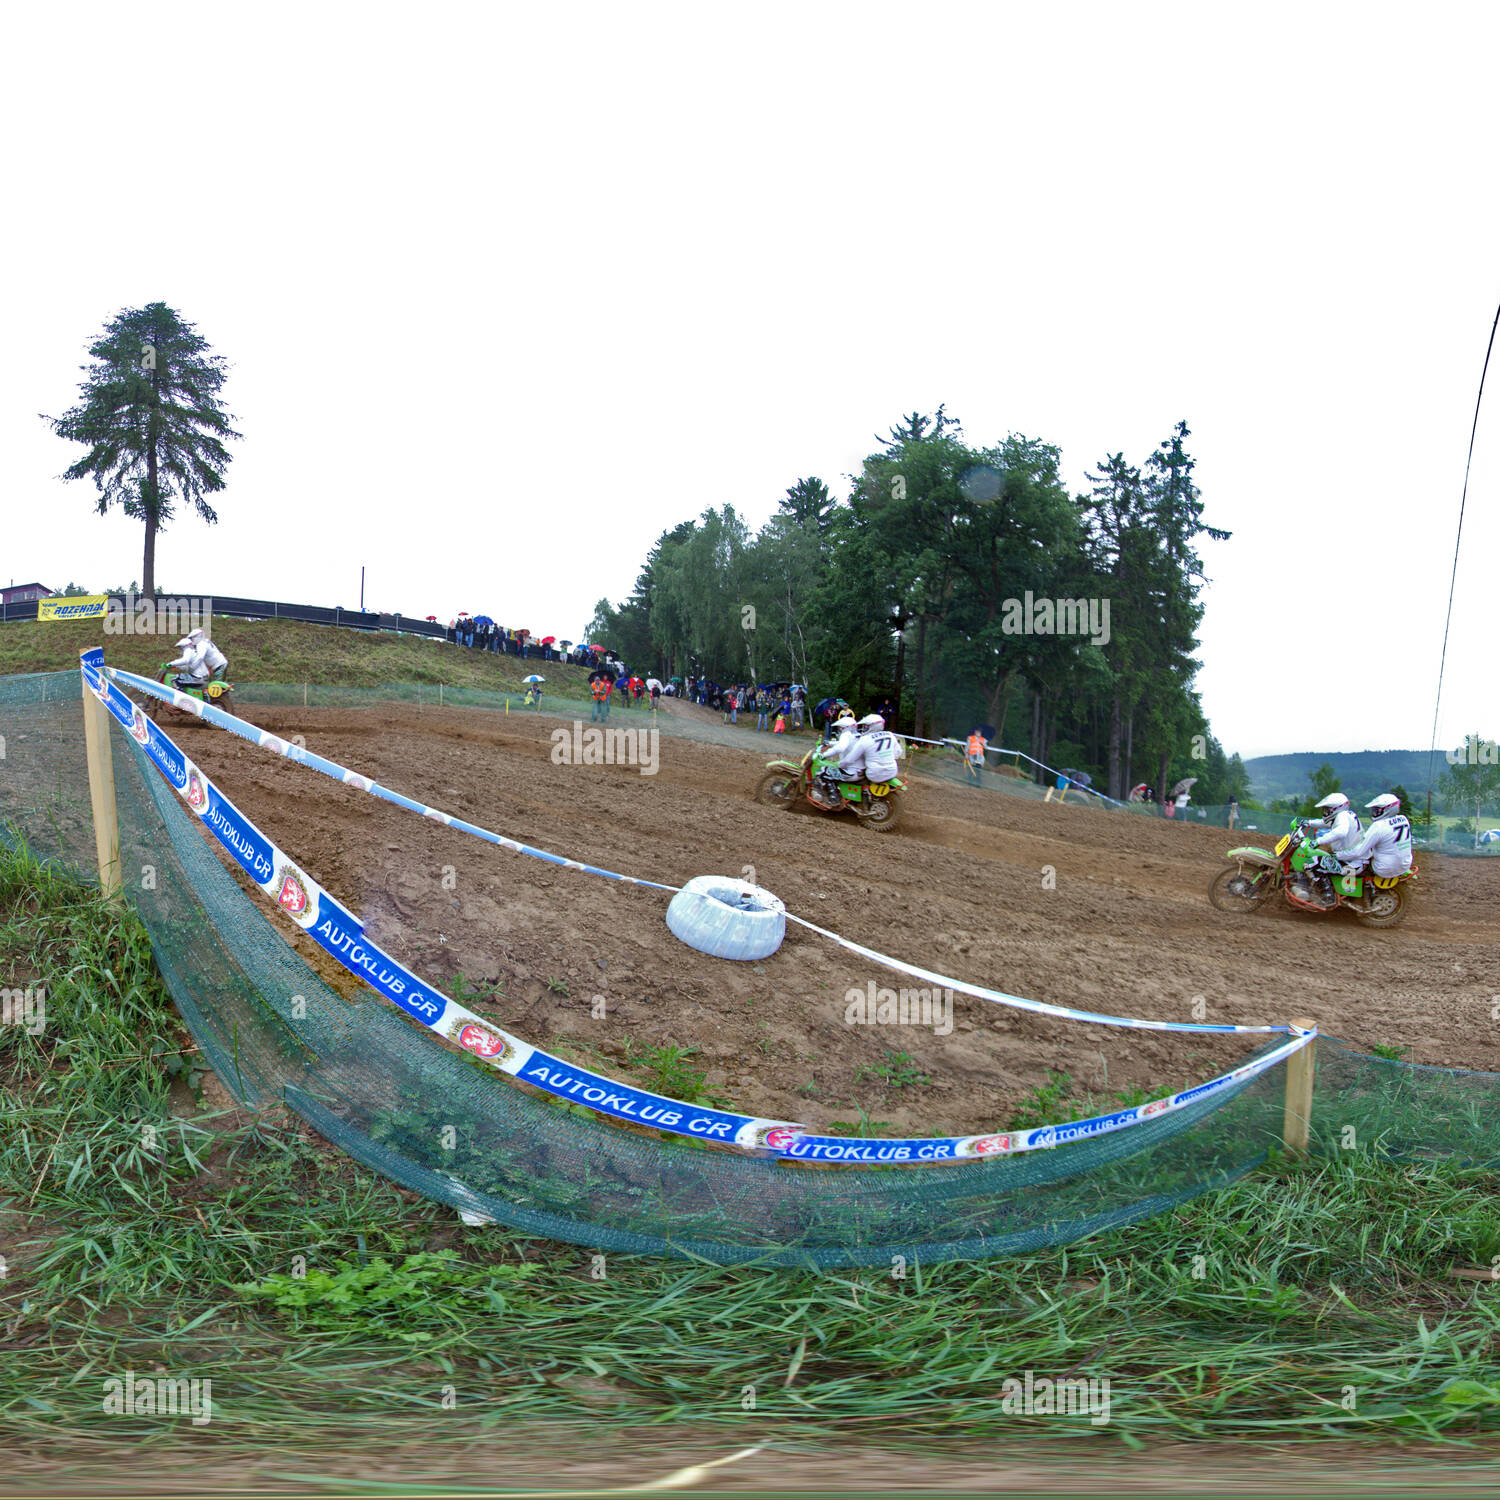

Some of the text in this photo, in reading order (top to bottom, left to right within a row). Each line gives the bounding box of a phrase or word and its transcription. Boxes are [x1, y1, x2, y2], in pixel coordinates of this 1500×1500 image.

[875, 737, 892, 752] 77
[208, 806, 272, 878] AUTOKLUB ČR
[1393, 825, 1410, 844] 77
[318, 920, 439, 1018] AUTOKLUB ČR
[528, 1066, 684, 1127] AUTOKLUB
[688, 1115, 733, 1139] ČR
[783, 1140, 950, 1160] UTOKLUB ČR
